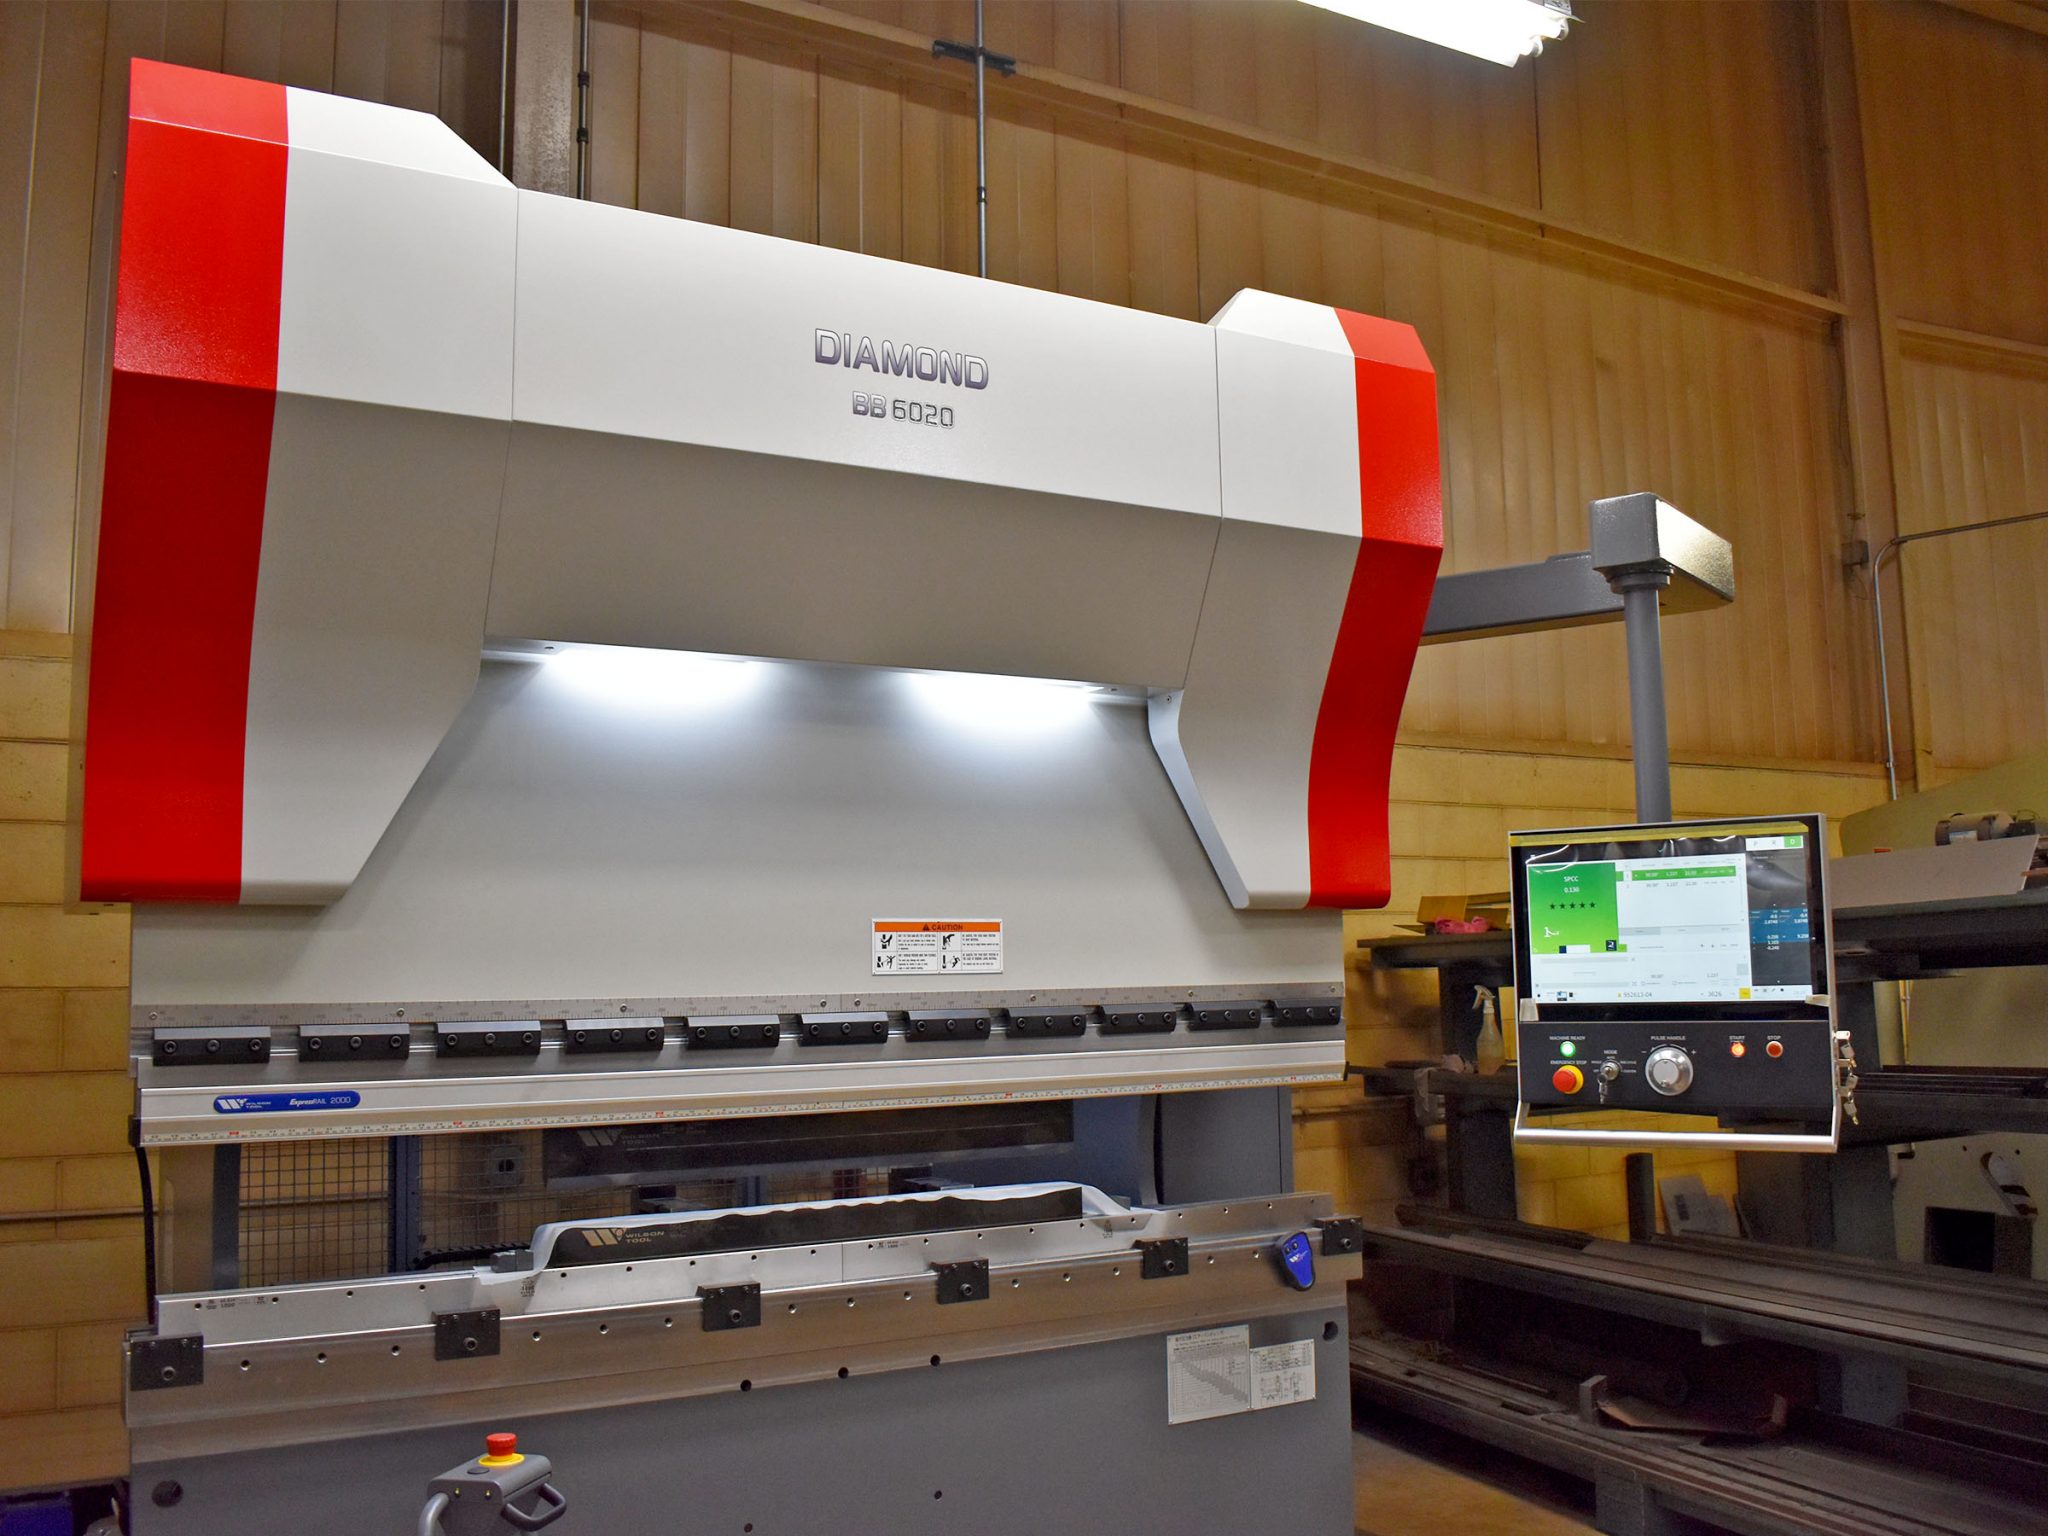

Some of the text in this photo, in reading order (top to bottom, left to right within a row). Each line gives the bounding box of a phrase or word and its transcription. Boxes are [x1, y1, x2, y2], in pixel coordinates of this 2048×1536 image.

[815, 328, 989, 390] DIAMOND
[852, 390, 954, 429] BB 6020
[330, 1096, 352, 1104] 2000
[625, 1231, 665, 1239] WILSON
